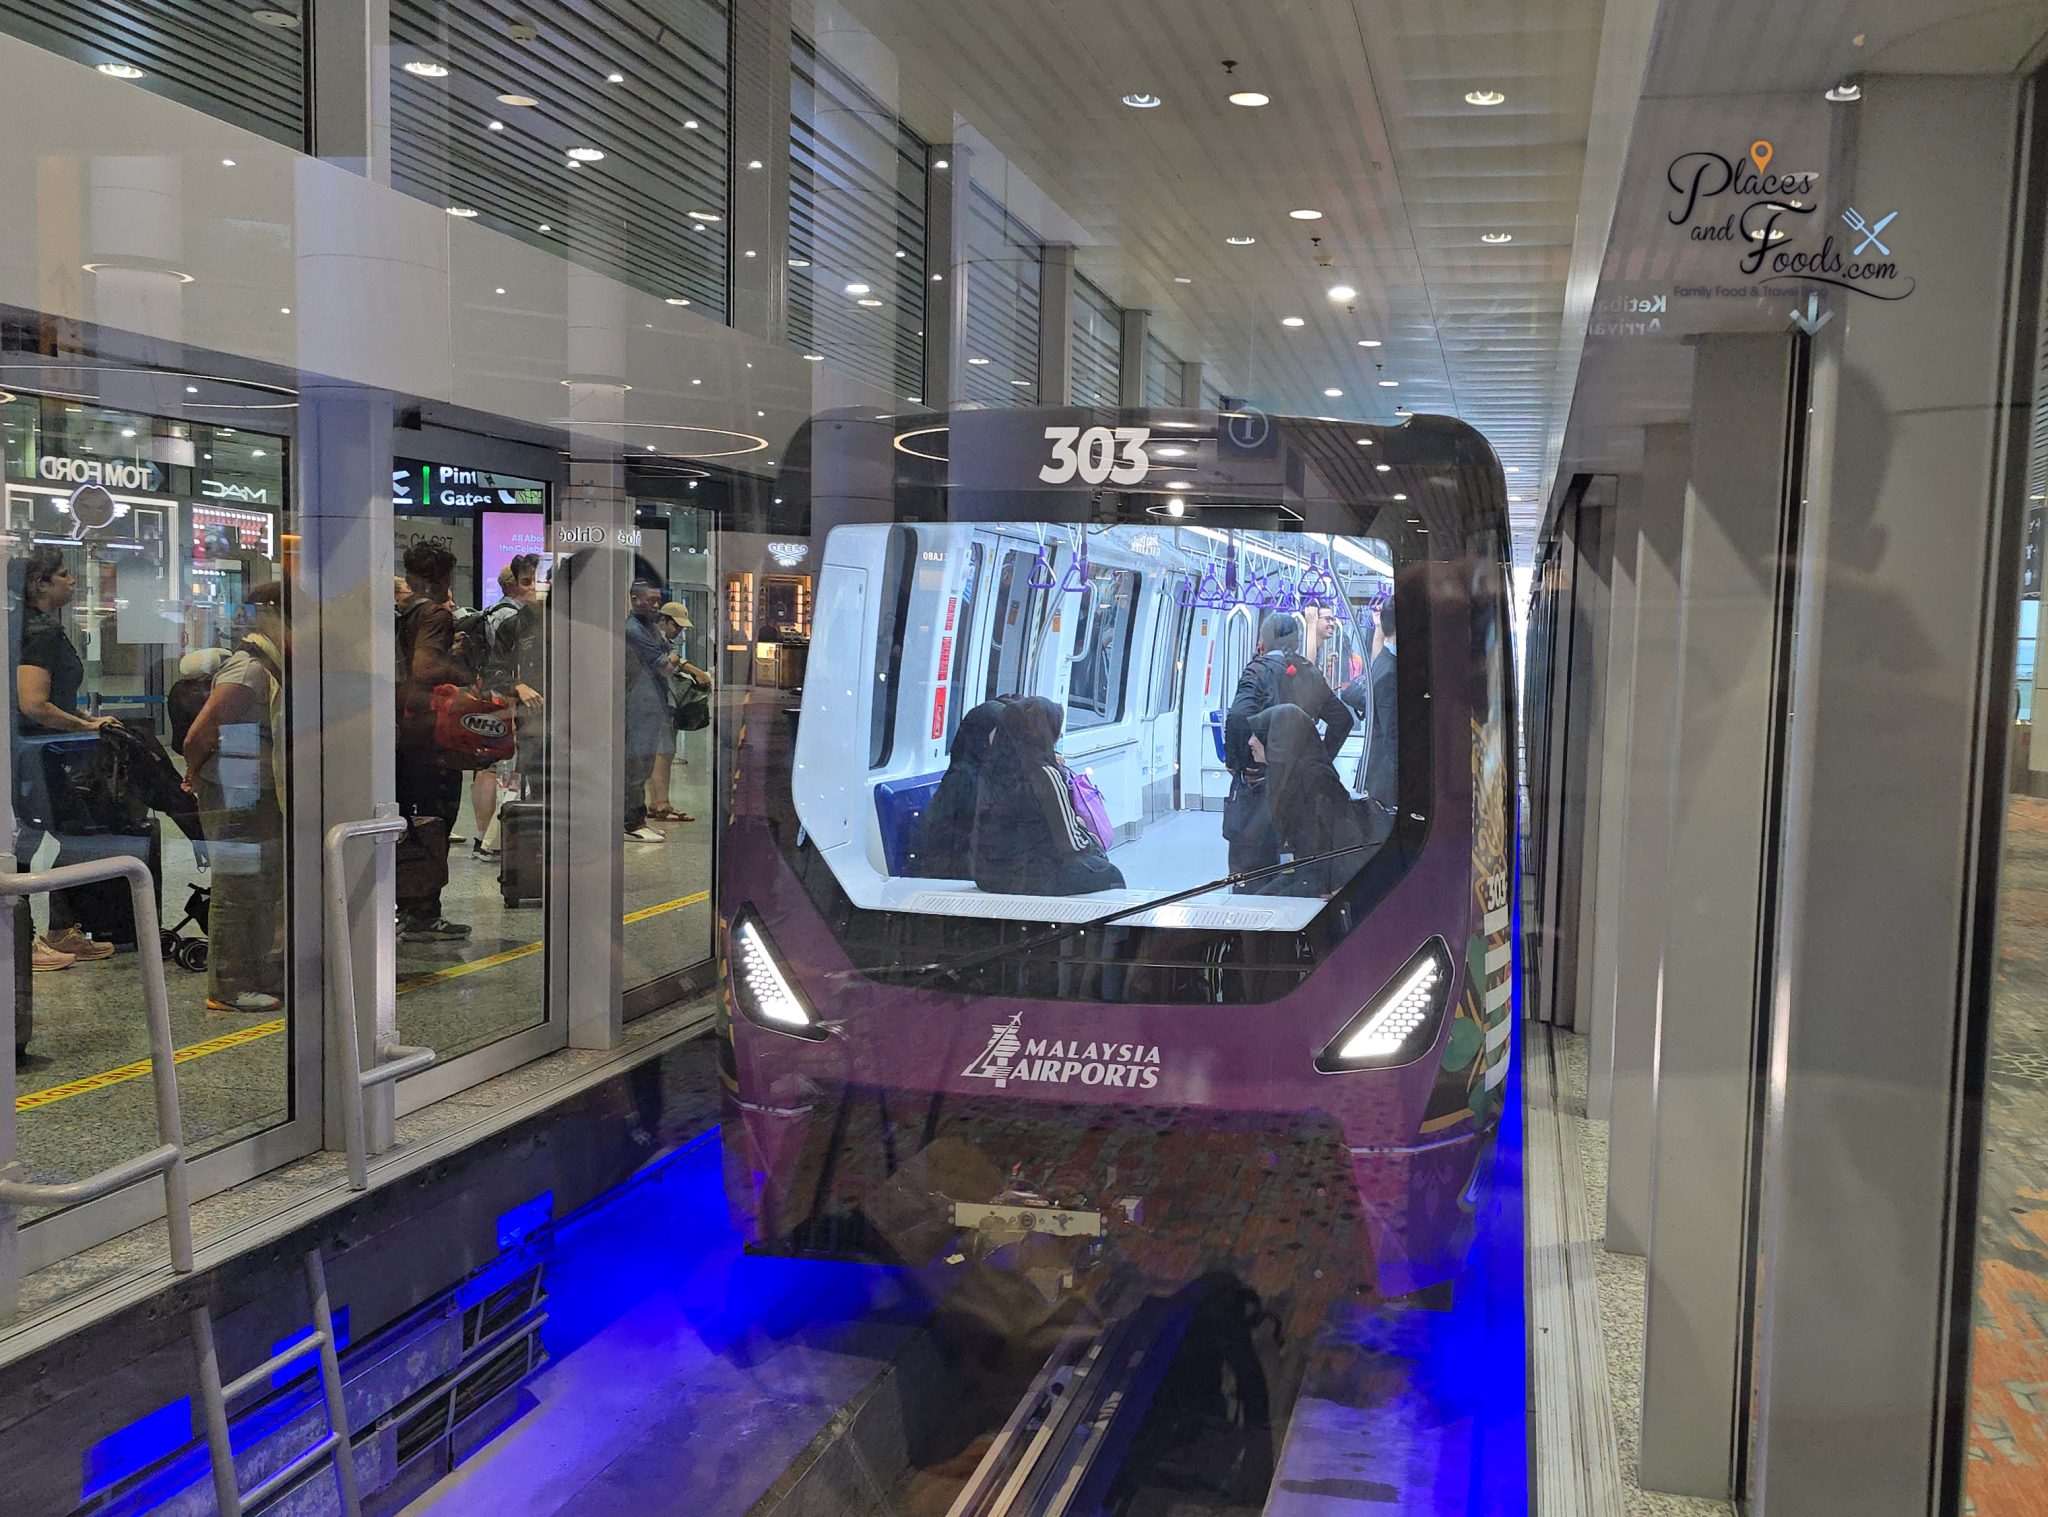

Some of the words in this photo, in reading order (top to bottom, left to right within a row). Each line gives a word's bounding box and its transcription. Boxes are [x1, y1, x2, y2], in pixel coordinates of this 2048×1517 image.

[1038, 427, 1151, 485] 303
[440, 489, 493, 506] Gates
[1024, 1038, 1161, 1064] MALAYSIA
[1009, 1058, 1161, 1089] AIRPORTS
